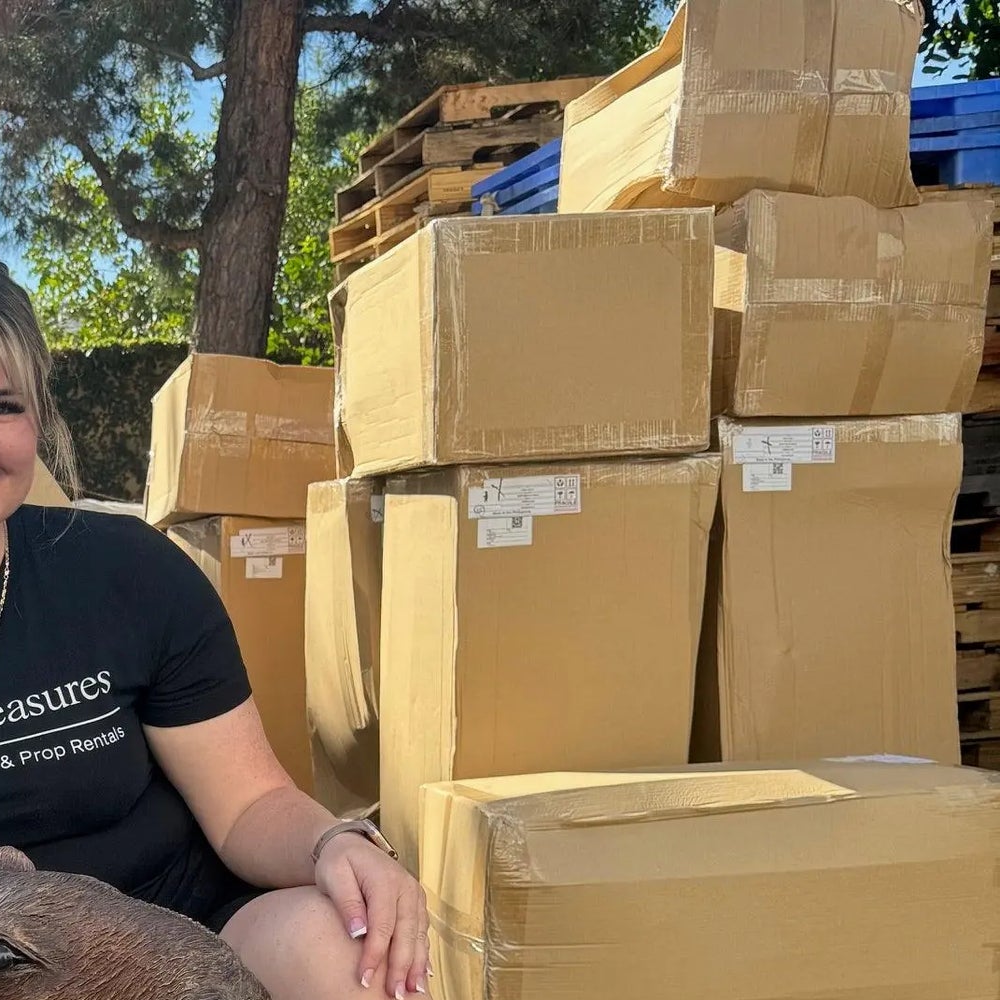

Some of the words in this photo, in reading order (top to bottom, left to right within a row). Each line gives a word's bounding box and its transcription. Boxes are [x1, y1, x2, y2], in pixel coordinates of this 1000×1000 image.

[0, 755, 15, 769] &
[19, 744, 66, 765] Prop
[70, 725, 125, 754] Rentals
